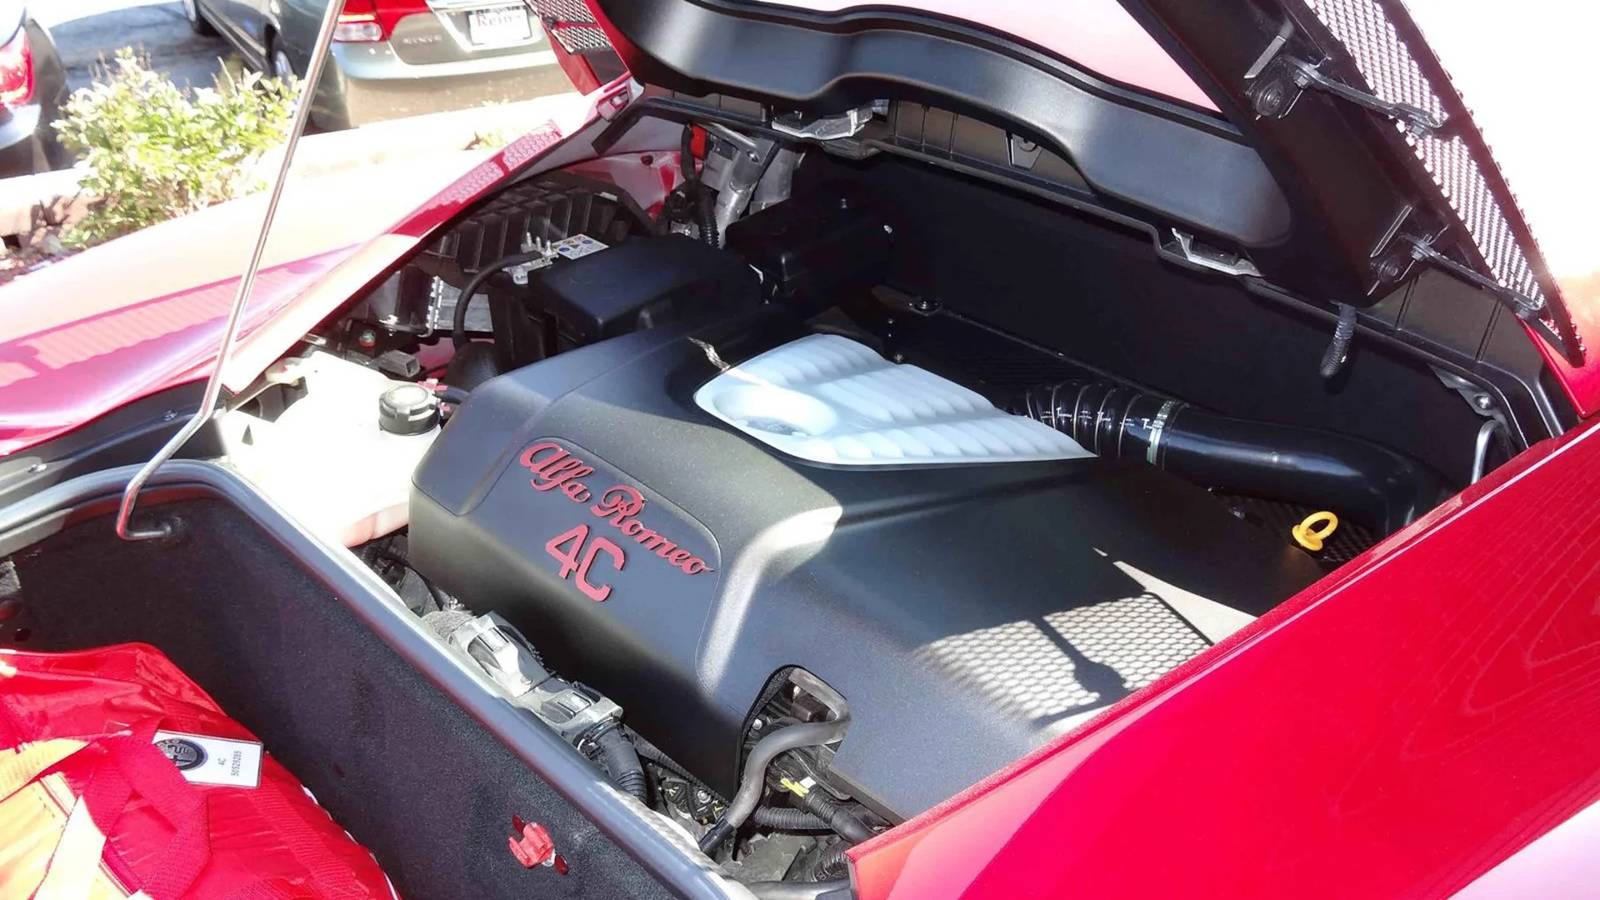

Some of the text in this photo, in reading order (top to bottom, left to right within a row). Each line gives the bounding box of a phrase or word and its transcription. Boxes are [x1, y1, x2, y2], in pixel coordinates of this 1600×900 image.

[520, 442, 714, 575] Alfa Romeo
[545, 523, 626, 602] 4C
